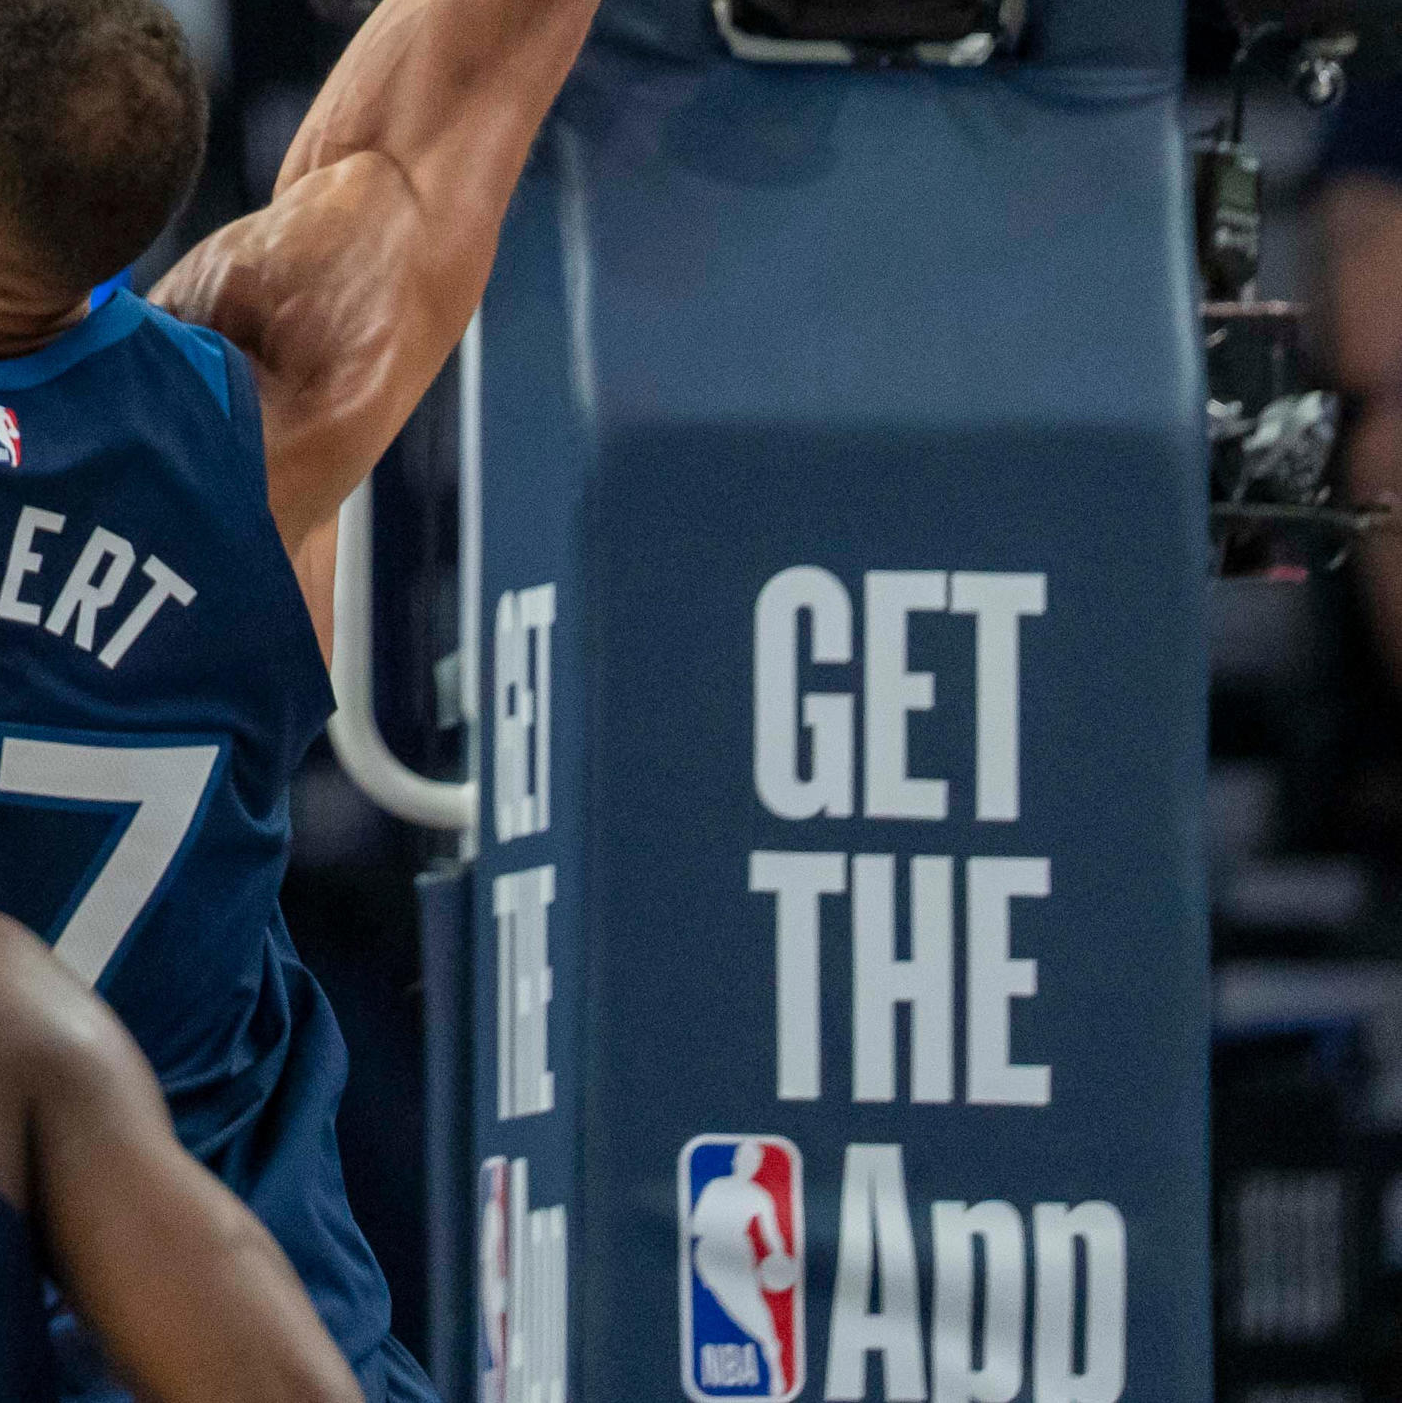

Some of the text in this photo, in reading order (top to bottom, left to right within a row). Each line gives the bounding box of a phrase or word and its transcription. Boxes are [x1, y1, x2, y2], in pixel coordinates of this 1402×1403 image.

[753, 565, 1047, 823] GET
[748, 850, 1052, 1107] THE
[823, 1142, 1127, 1403] App
